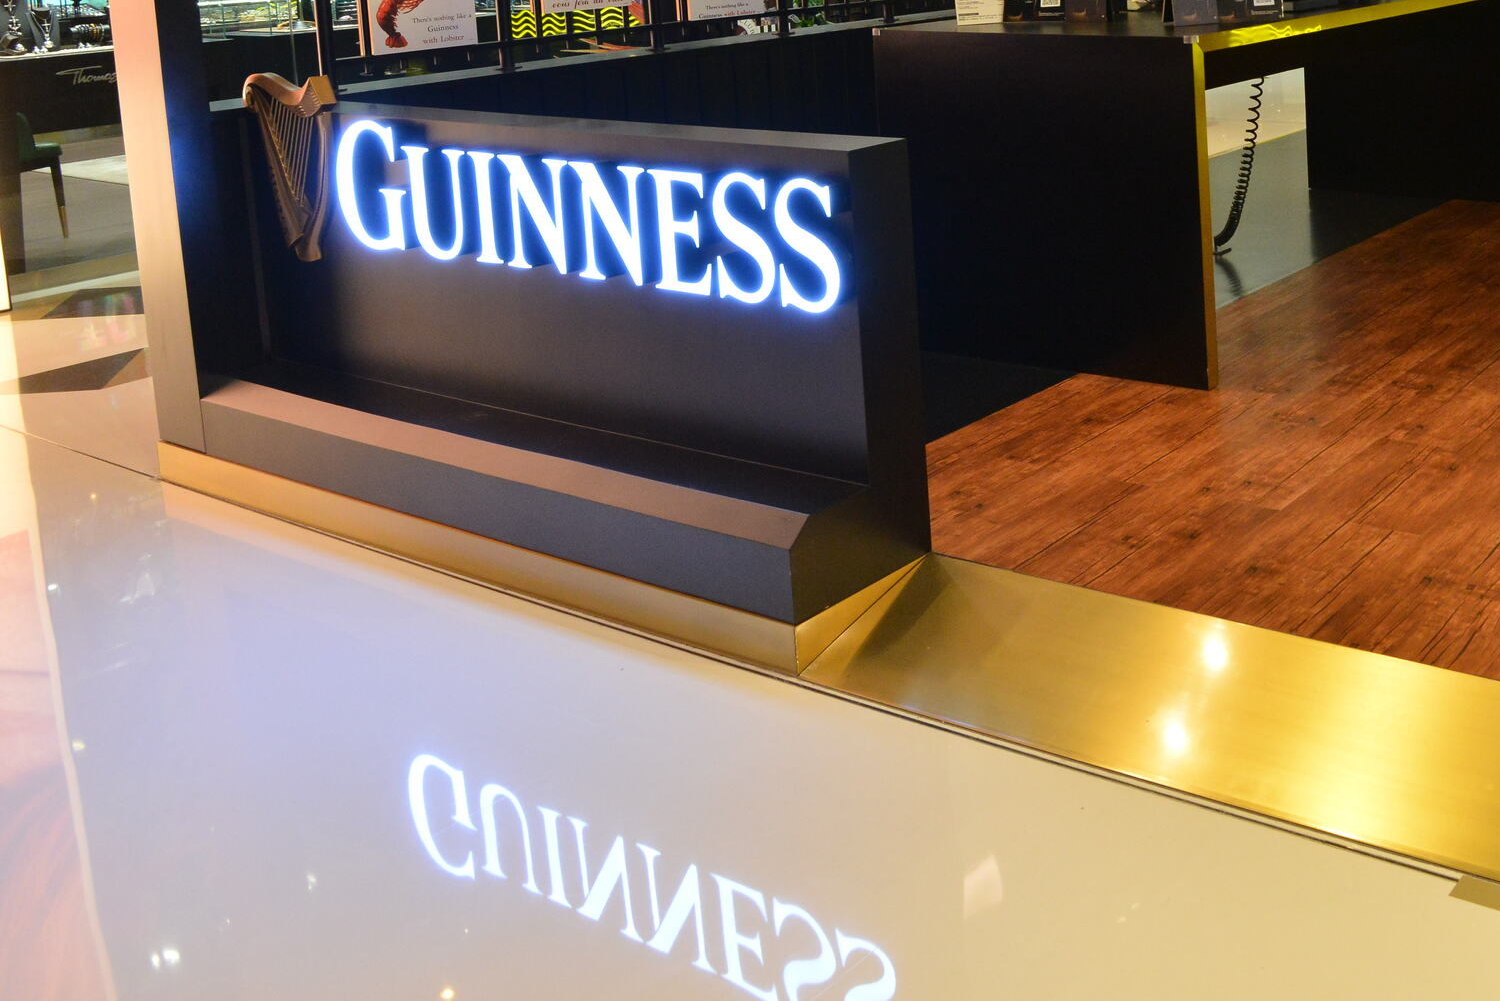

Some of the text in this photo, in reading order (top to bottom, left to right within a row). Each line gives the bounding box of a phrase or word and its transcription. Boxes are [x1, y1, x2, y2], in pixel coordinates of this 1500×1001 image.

[552, 0, 570, 8] vous
[413, 16, 431, 24] There's
[434, 14, 455, 23] nothing
[427, 24, 459, 32] Guinness
[440, 34, 465, 43] Lobster
[335, 119, 841, 314] GUINNESS
